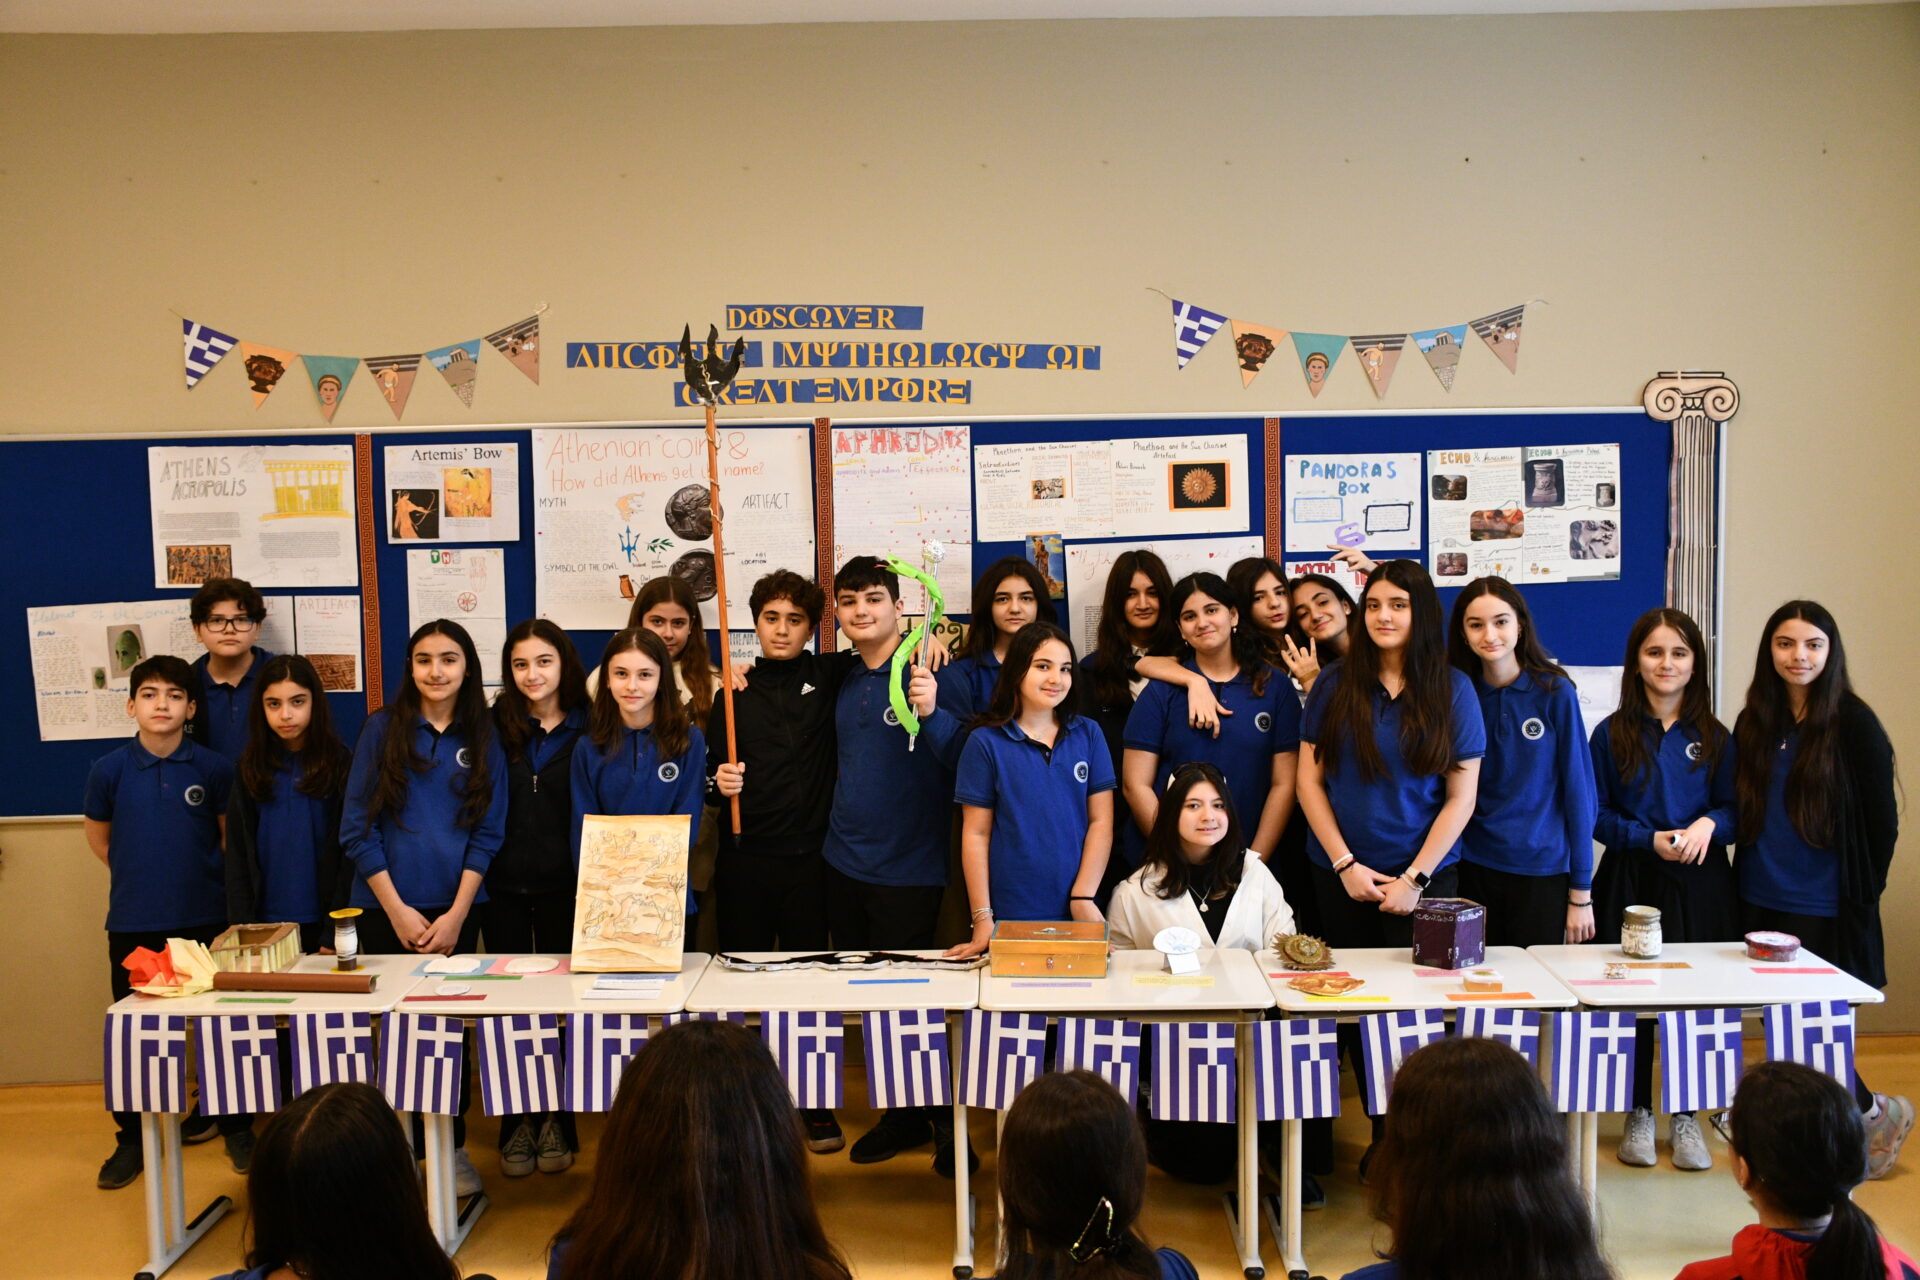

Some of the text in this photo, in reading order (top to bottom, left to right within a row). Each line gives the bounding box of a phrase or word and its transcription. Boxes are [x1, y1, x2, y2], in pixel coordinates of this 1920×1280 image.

[546, 432, 651, 470] Athenian
[728, 431, 749, 460] &
[835, 429, 968, 454] APHRODITE
[473, 447, 503, 460] Bow
[160, 456, 231, 483] ATHENS
[552, 467, 586, 492] How
[593, 465, 618, 488] did
[1300, 460, 1397, 479] PANDORAS
[1338, 481, 1370, 496] BOX
[539, 497, 567, 508] MYTH
[741, 492, 791, 511] ARTIFACT
[544, 564, 577, 573] SYMBOL
[602, 562, 619, 571] OWL
[1295, 562, 1335, 574] MYTH
